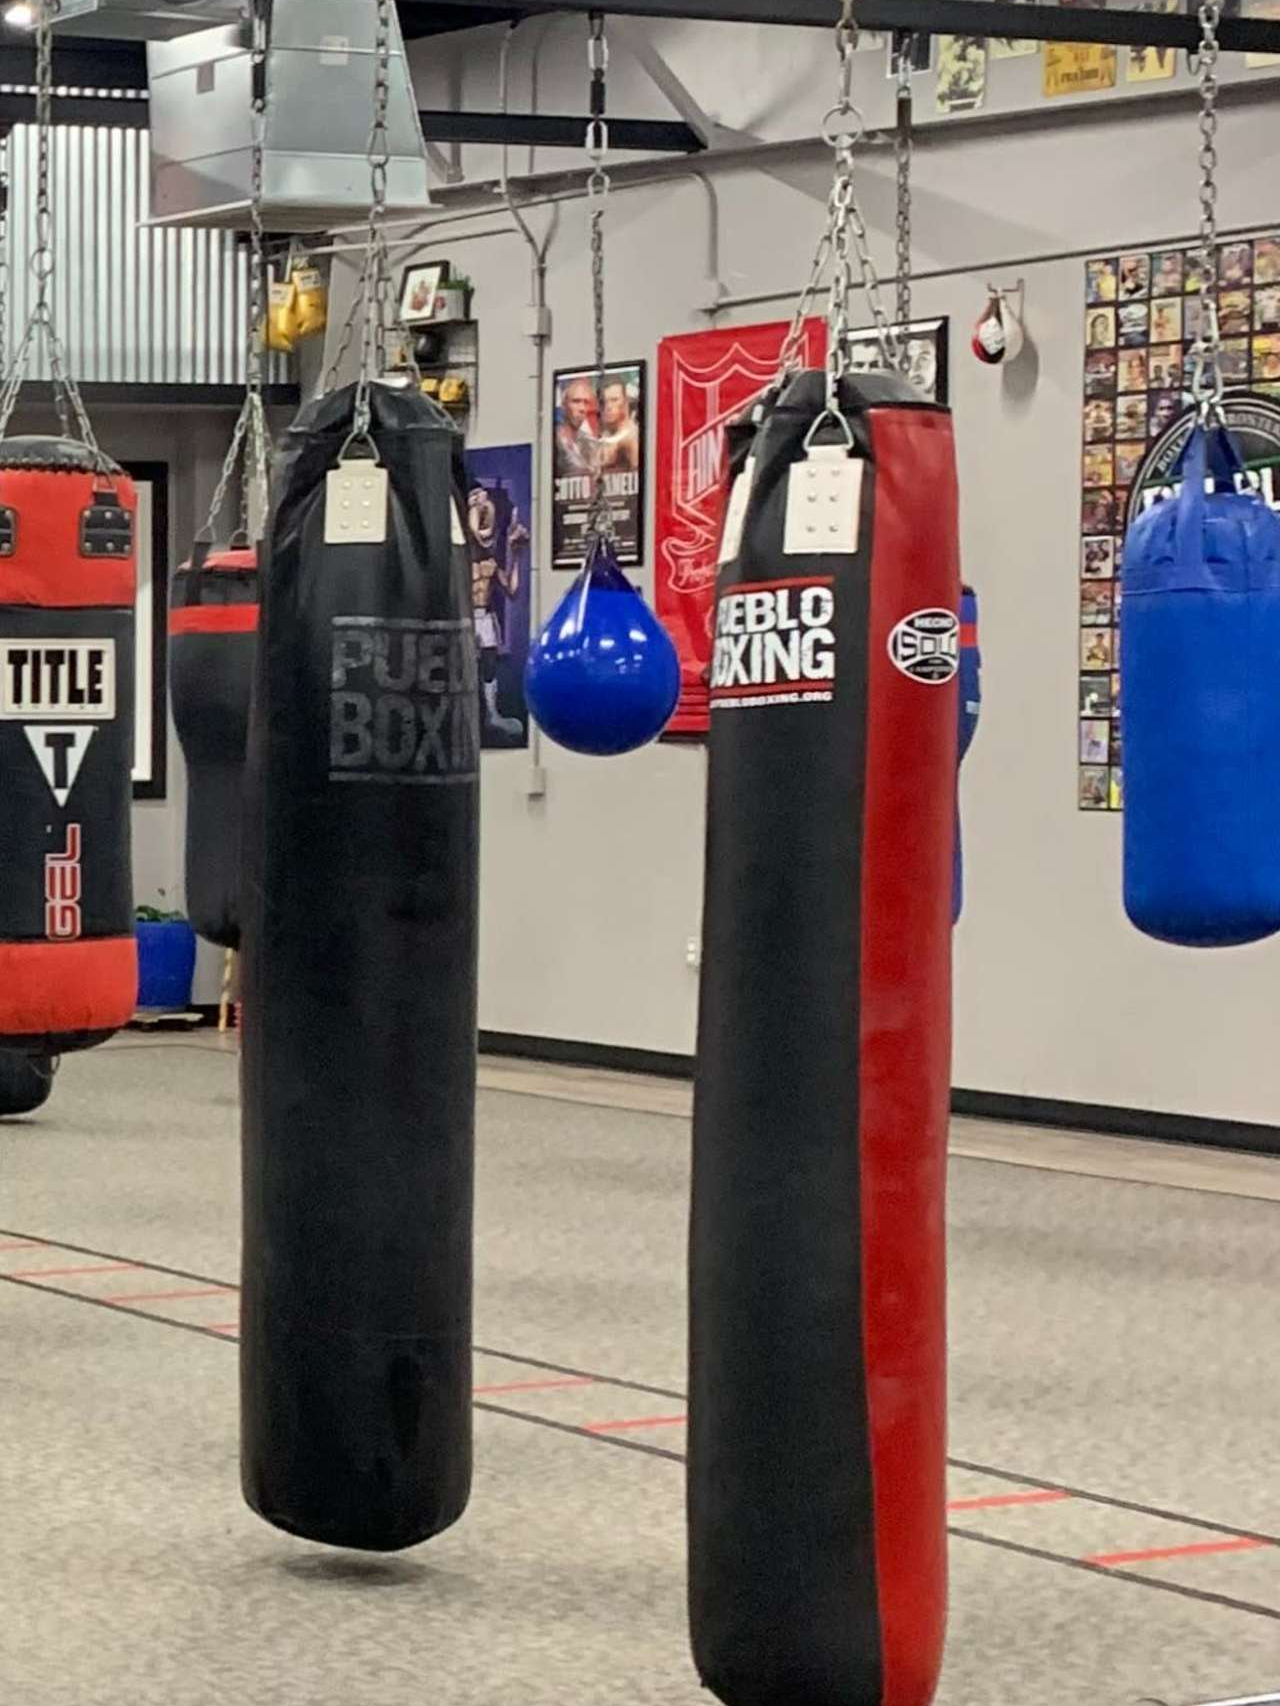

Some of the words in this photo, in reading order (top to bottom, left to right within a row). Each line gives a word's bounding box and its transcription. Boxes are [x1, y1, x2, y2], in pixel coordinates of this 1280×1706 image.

[7, 648, 104, 705] TITLE
[44, 731, 76, 789] T
[44, 822, 82, 941] GEL
